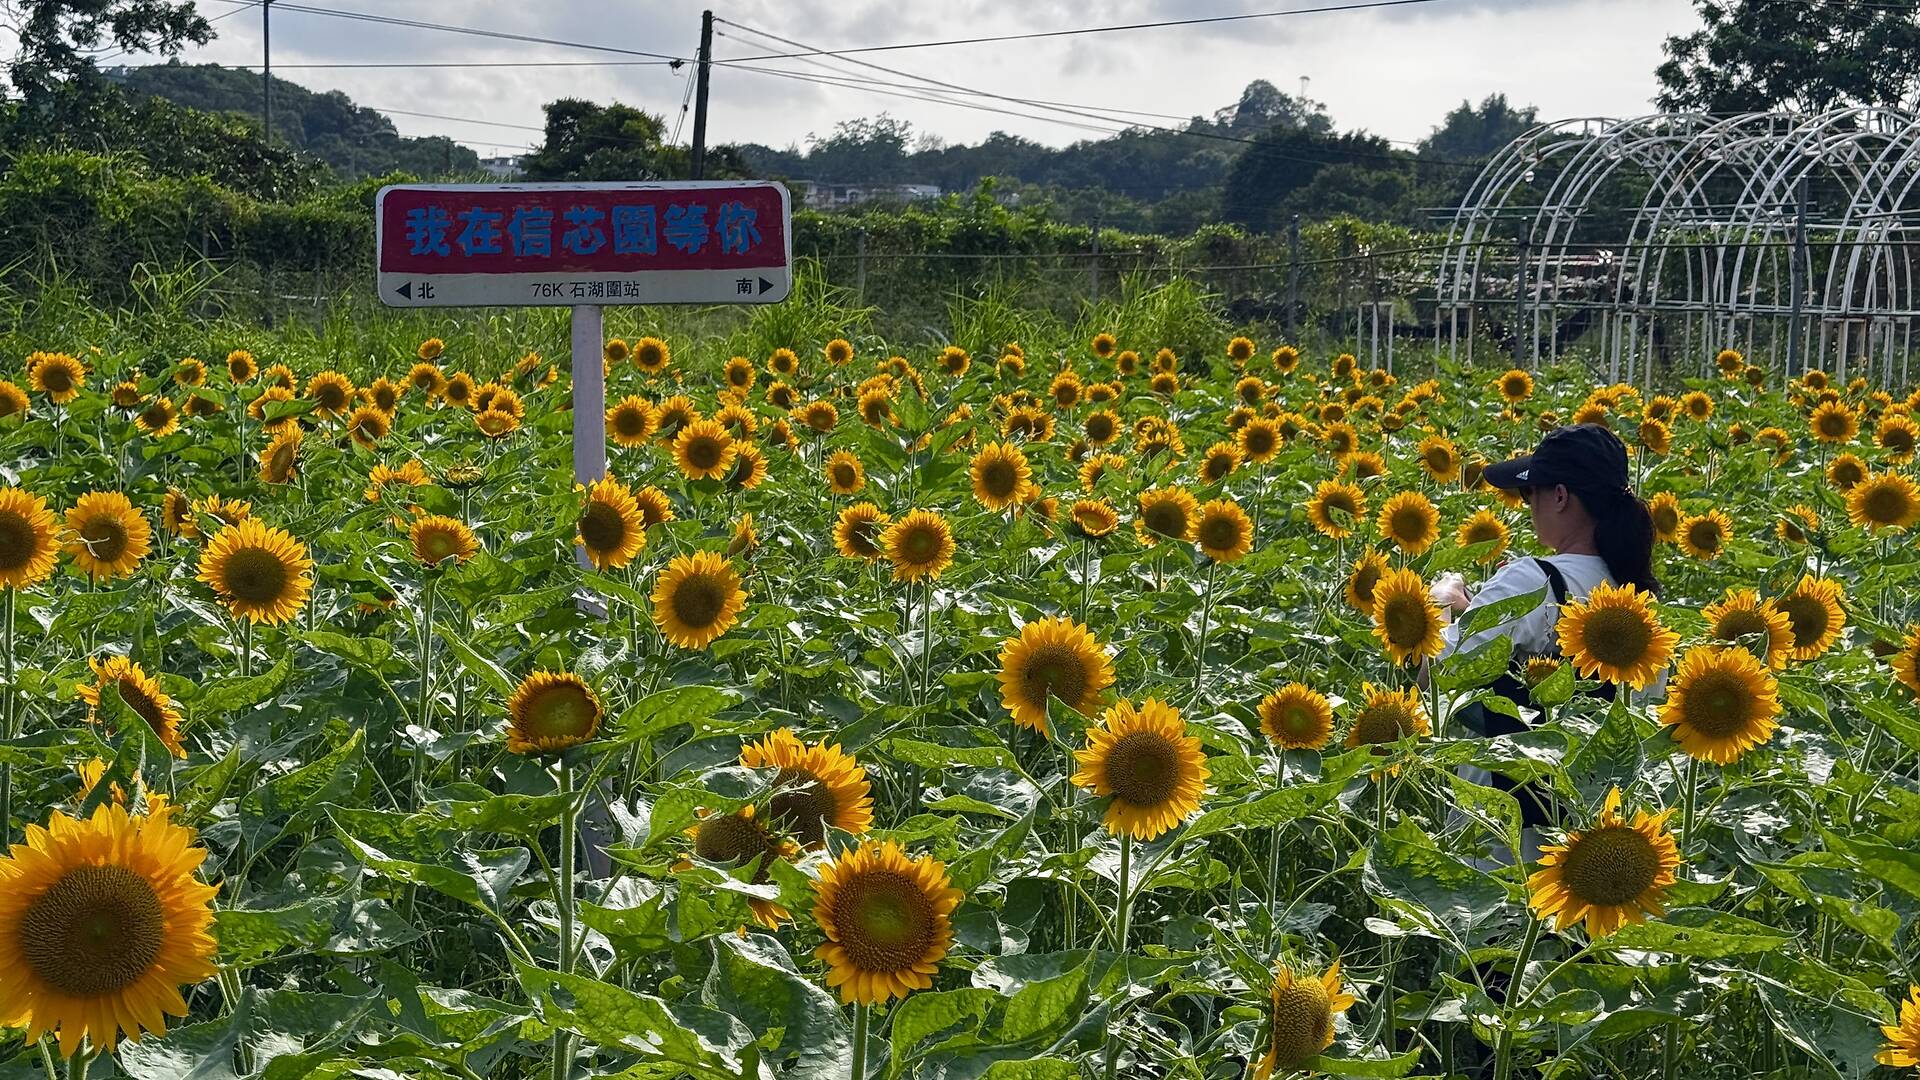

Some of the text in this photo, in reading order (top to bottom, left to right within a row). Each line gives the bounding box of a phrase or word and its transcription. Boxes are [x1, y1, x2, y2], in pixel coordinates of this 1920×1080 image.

[406, 202, 762, 257] 我在信芯園等你
[418, 282, 435, 299] 北
[532, 281, 641, 298] 76K 石湖圍站
[736, 278, 753, 295] 南
